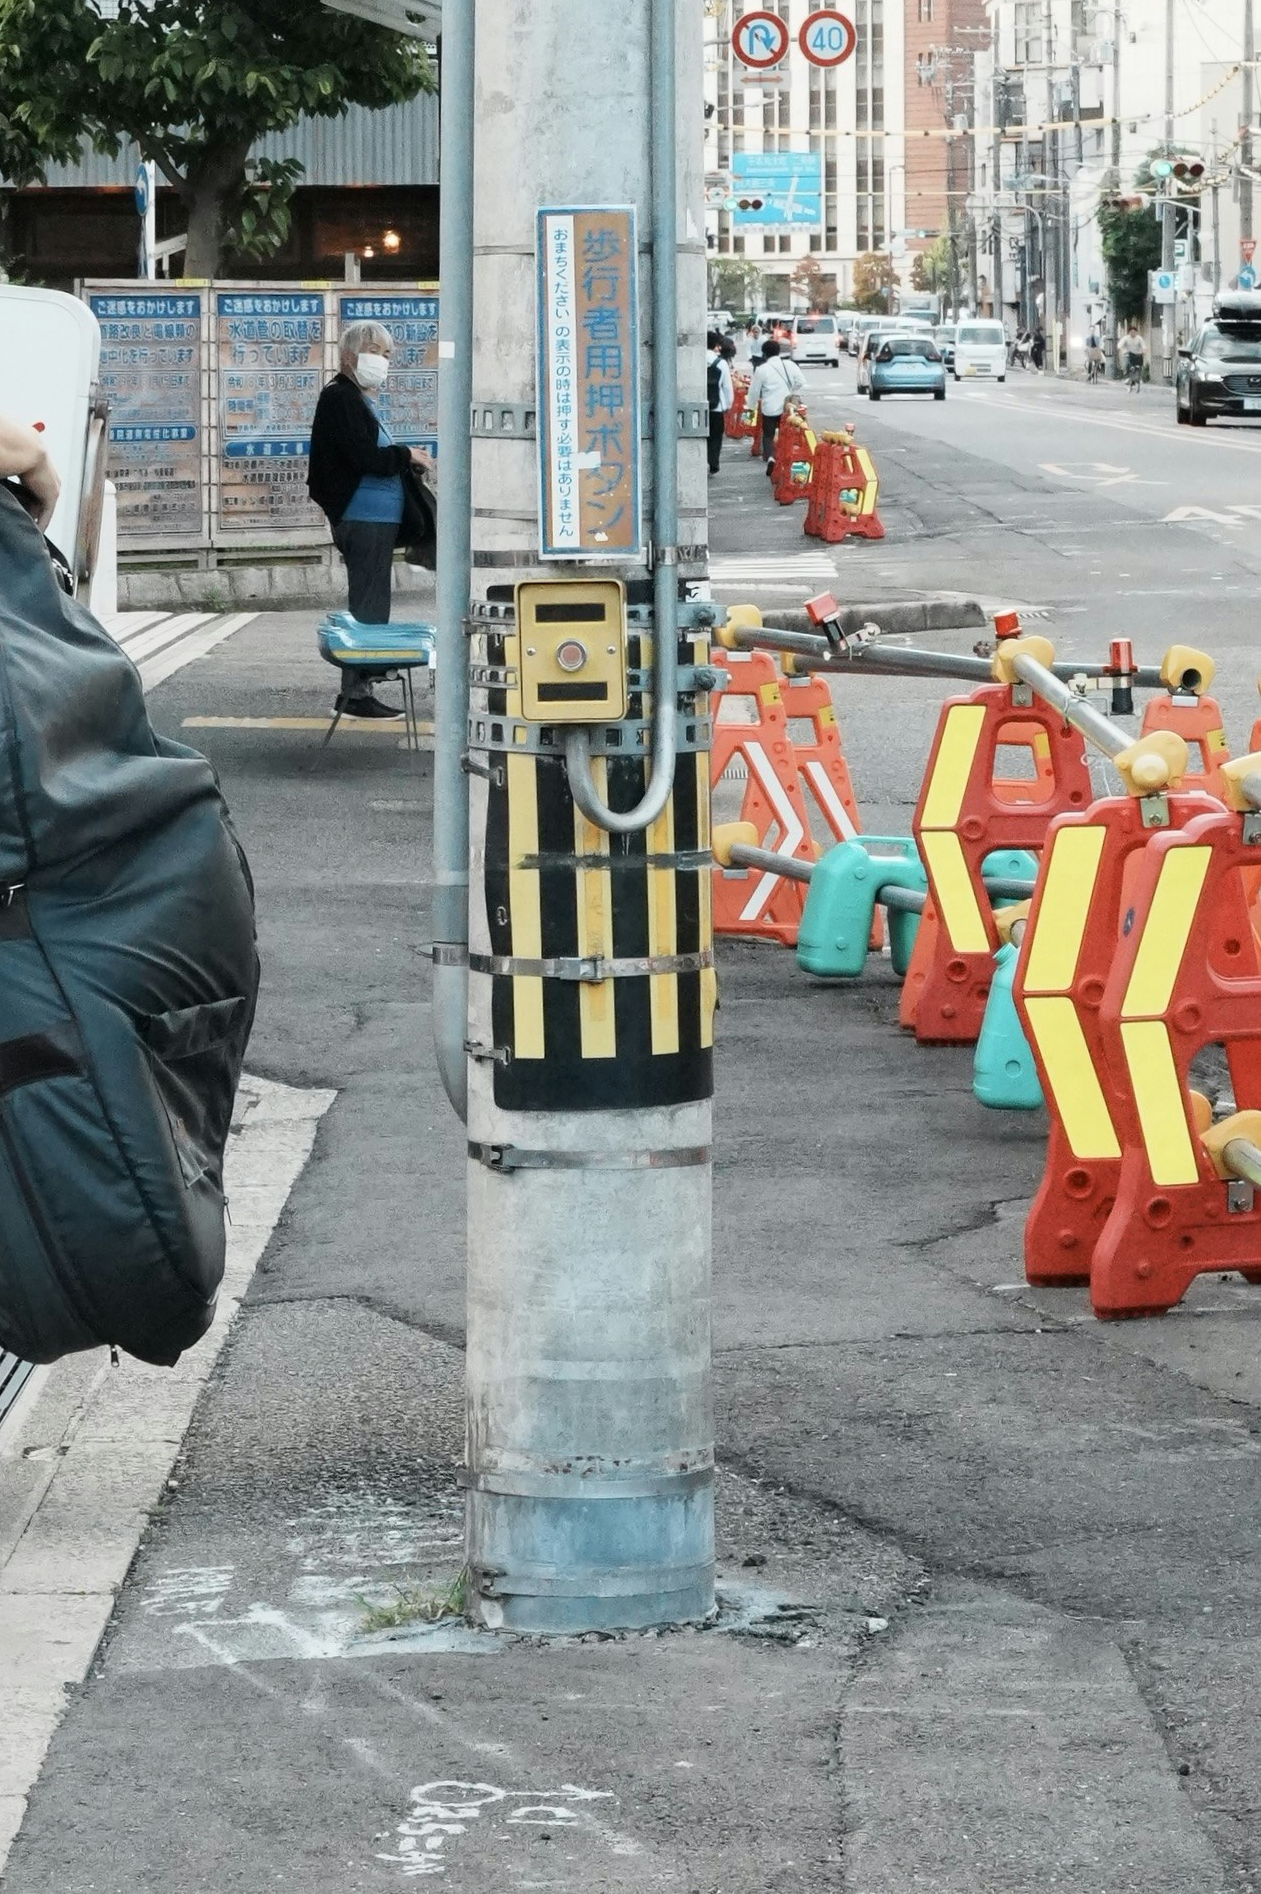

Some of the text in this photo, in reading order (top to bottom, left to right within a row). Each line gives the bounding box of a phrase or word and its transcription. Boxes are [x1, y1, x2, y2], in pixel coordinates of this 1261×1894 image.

[811, 26, 843, 51] 40
[98, 300, 195, 316] ご迷惑をおかけします
[224, 299, 319, 313] ご迷惑をおかけします
[346, 302, 437, 317] ご迷惑をおかけします
[228, 319, 322, 341] 水道管の取替を
[232, 345, 312, 365] 行っています
[582, 227, 626, 536] 歩行者用押ボタン
